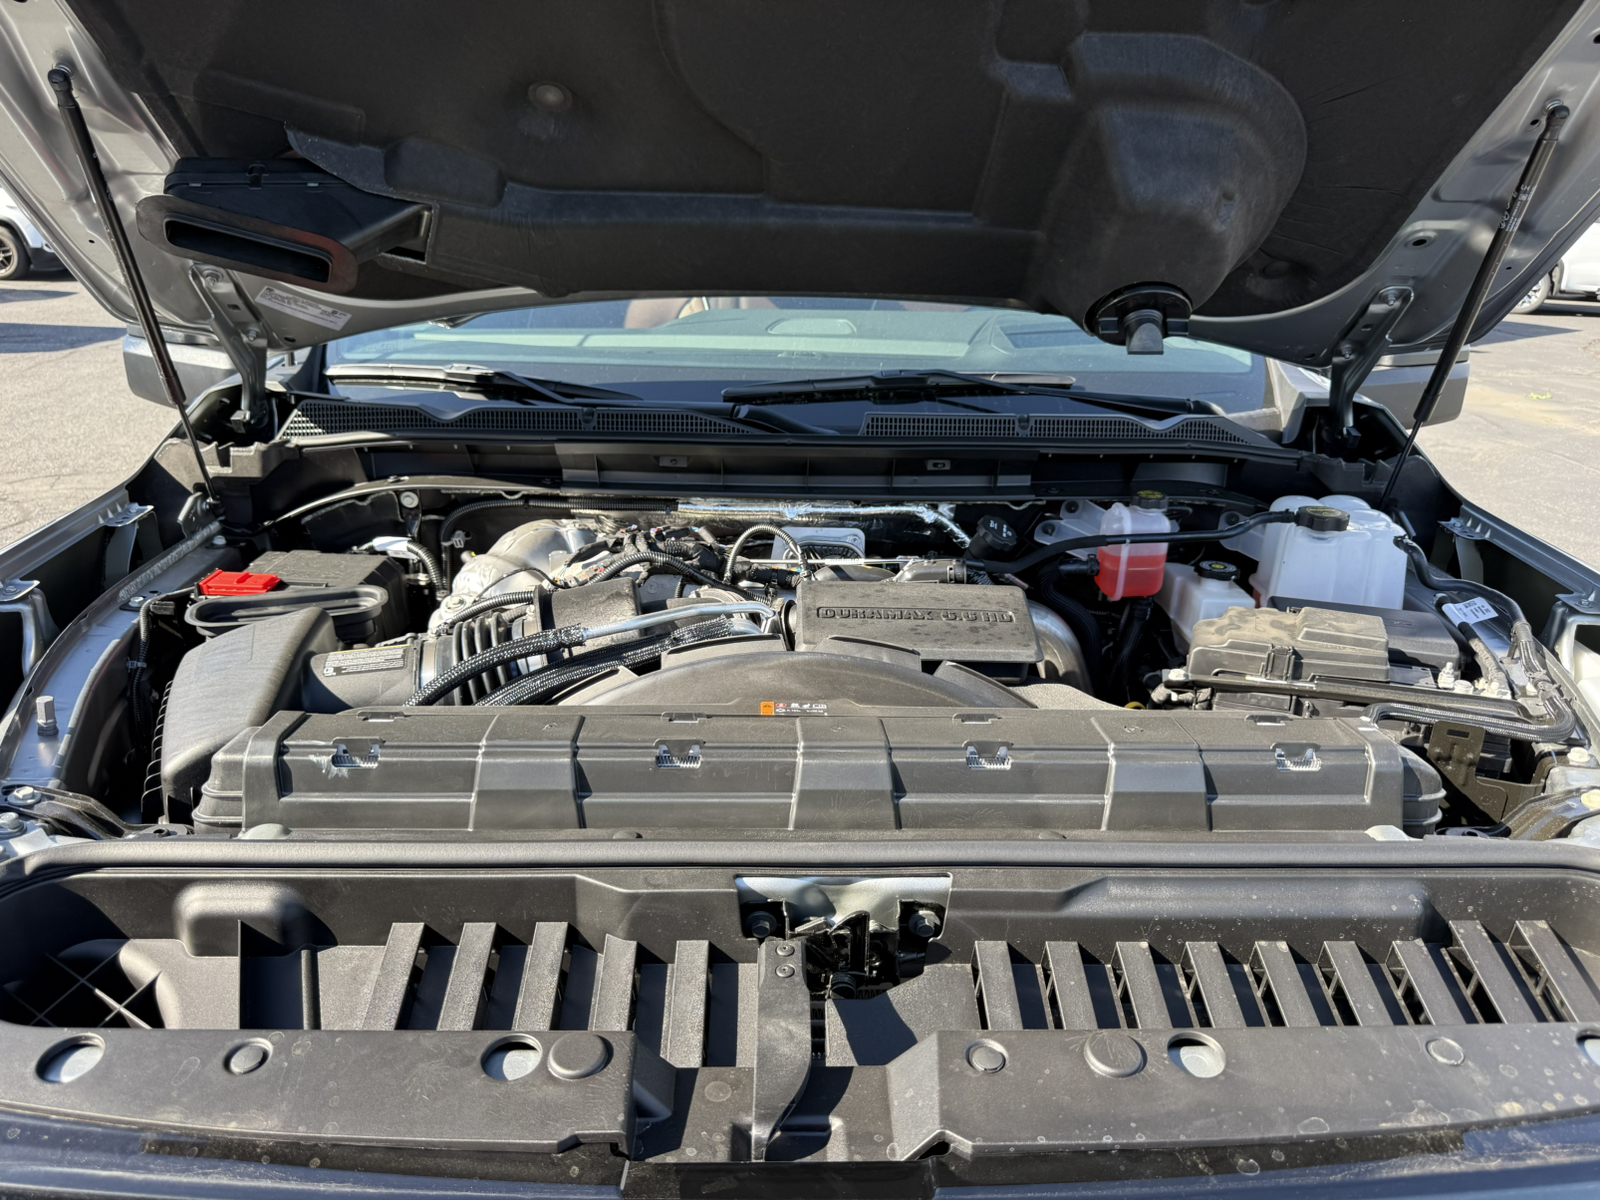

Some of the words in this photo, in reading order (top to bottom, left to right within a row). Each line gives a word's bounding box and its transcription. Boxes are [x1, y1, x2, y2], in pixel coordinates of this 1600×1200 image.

[821, 608, 934, 620] DURAMAX
[941, 610, 978, 622] 6.6
[981, 611, 1014, 623] HD
